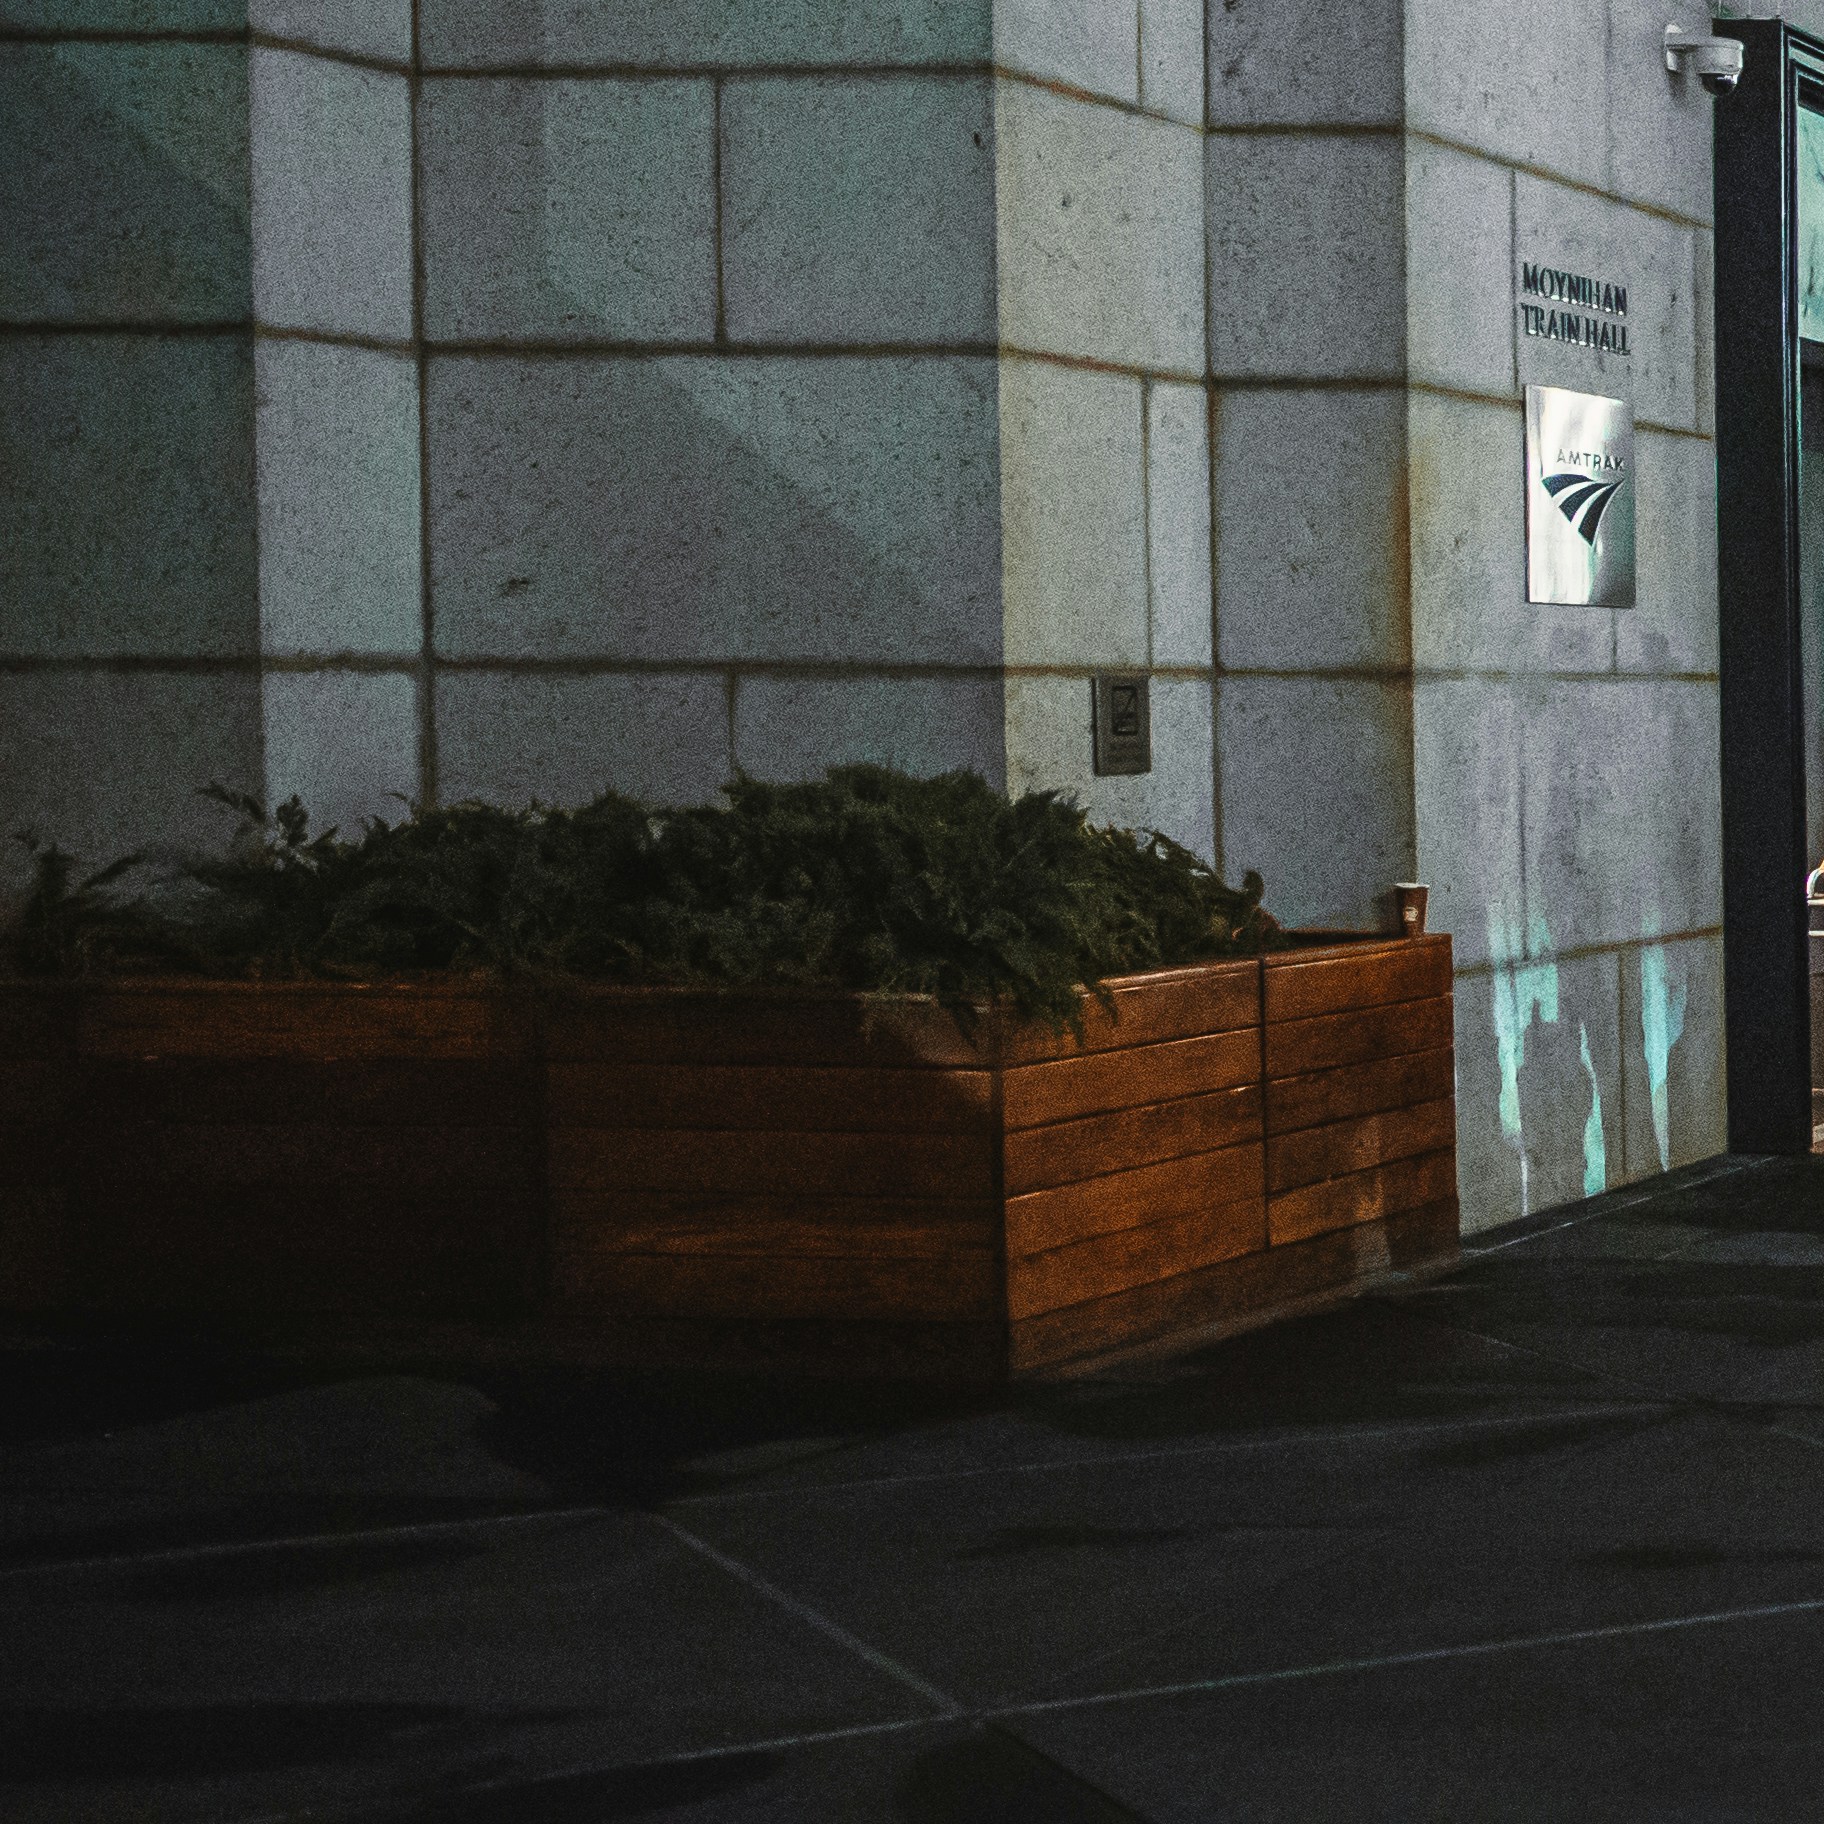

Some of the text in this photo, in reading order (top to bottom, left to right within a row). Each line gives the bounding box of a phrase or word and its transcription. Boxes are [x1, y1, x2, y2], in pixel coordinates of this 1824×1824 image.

[1522, 262, 1628, 316] MOYNIHAN
[1520, 302, 1632, 356] TRAIN HALL
[1556, 448, 1625, 472] AMTRAK
